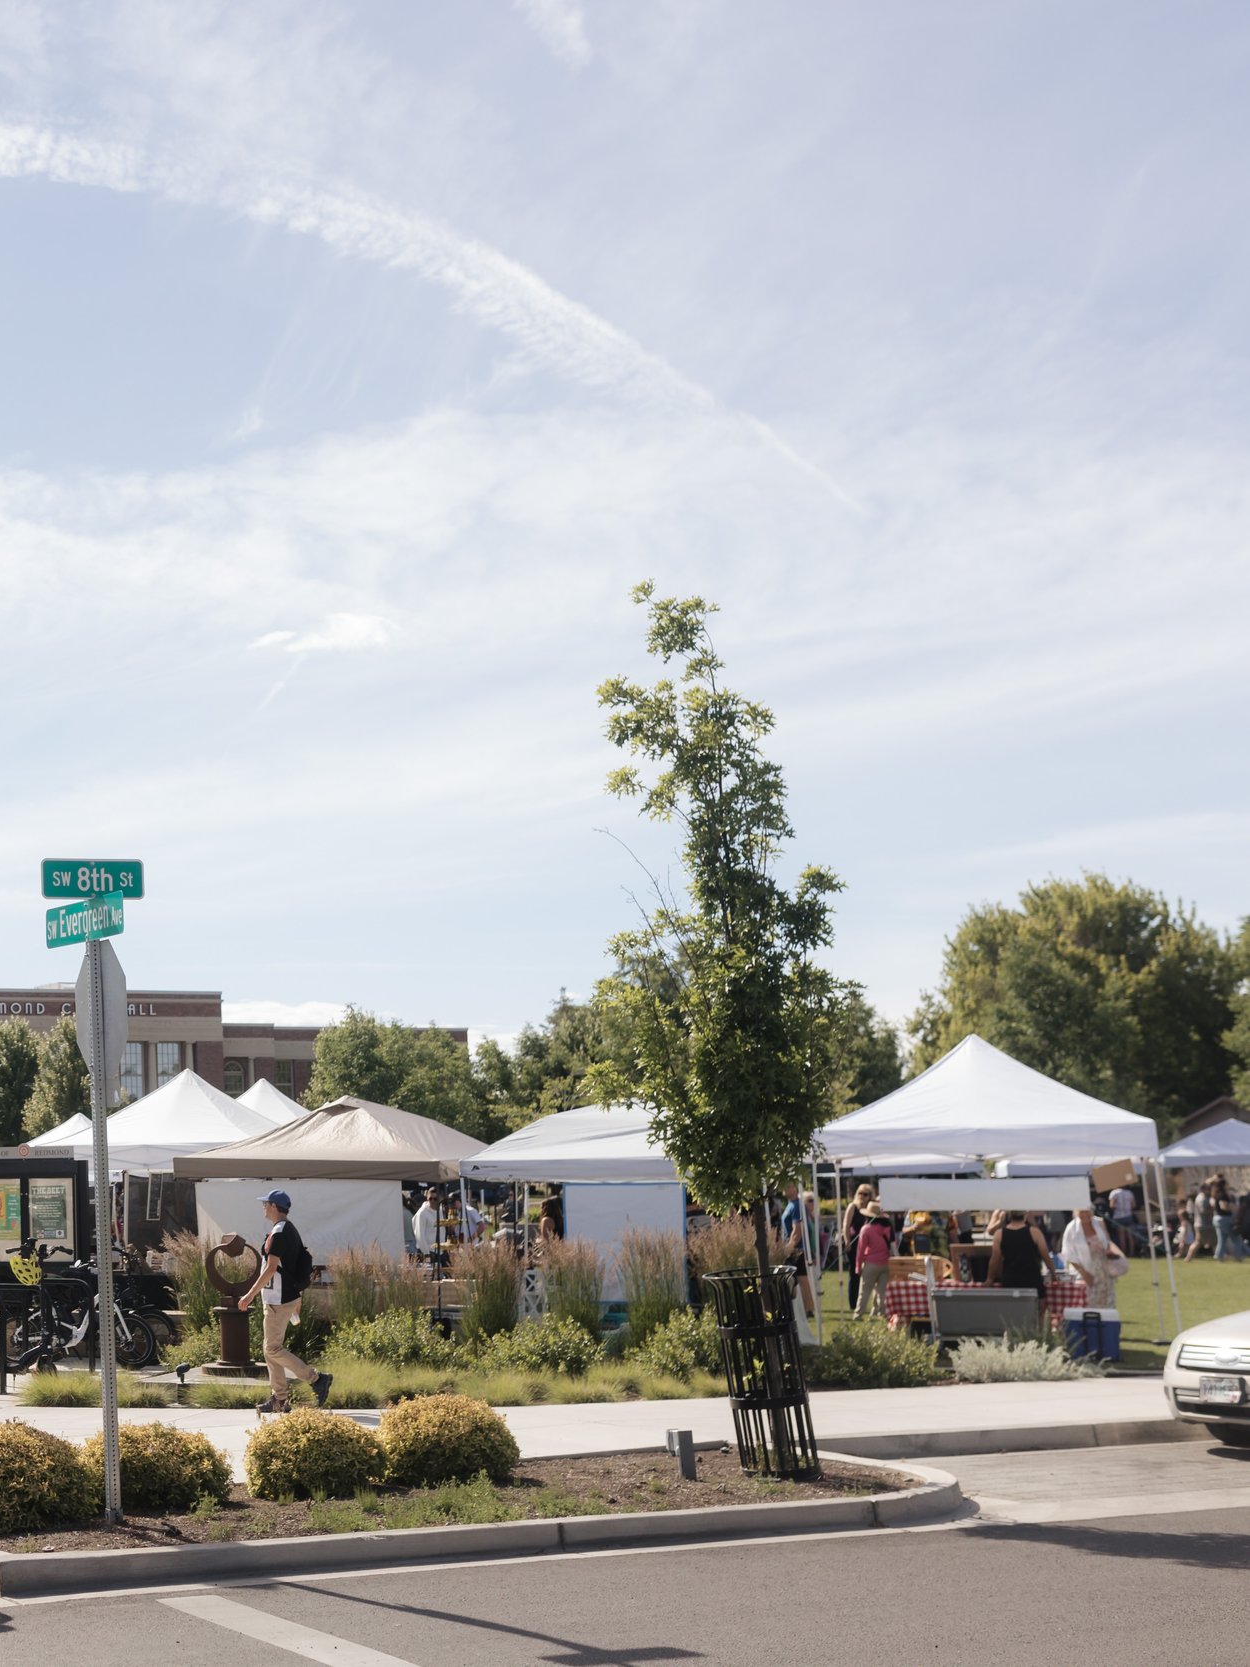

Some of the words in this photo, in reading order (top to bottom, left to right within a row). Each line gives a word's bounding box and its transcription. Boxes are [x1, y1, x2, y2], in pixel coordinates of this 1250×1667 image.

[52, 871, 72, 887] SW
[77, 867, 113, 892] 8th
[119, 872, 133, 888] St
[47, 920, 57, 940] SW
[59, 905, 109, 937] Evergreen
[111, 906, 122, 927] Ave
[127, 1003, 157, 1016] ALL
[34, 1148, 70, 1157] REDMOND
